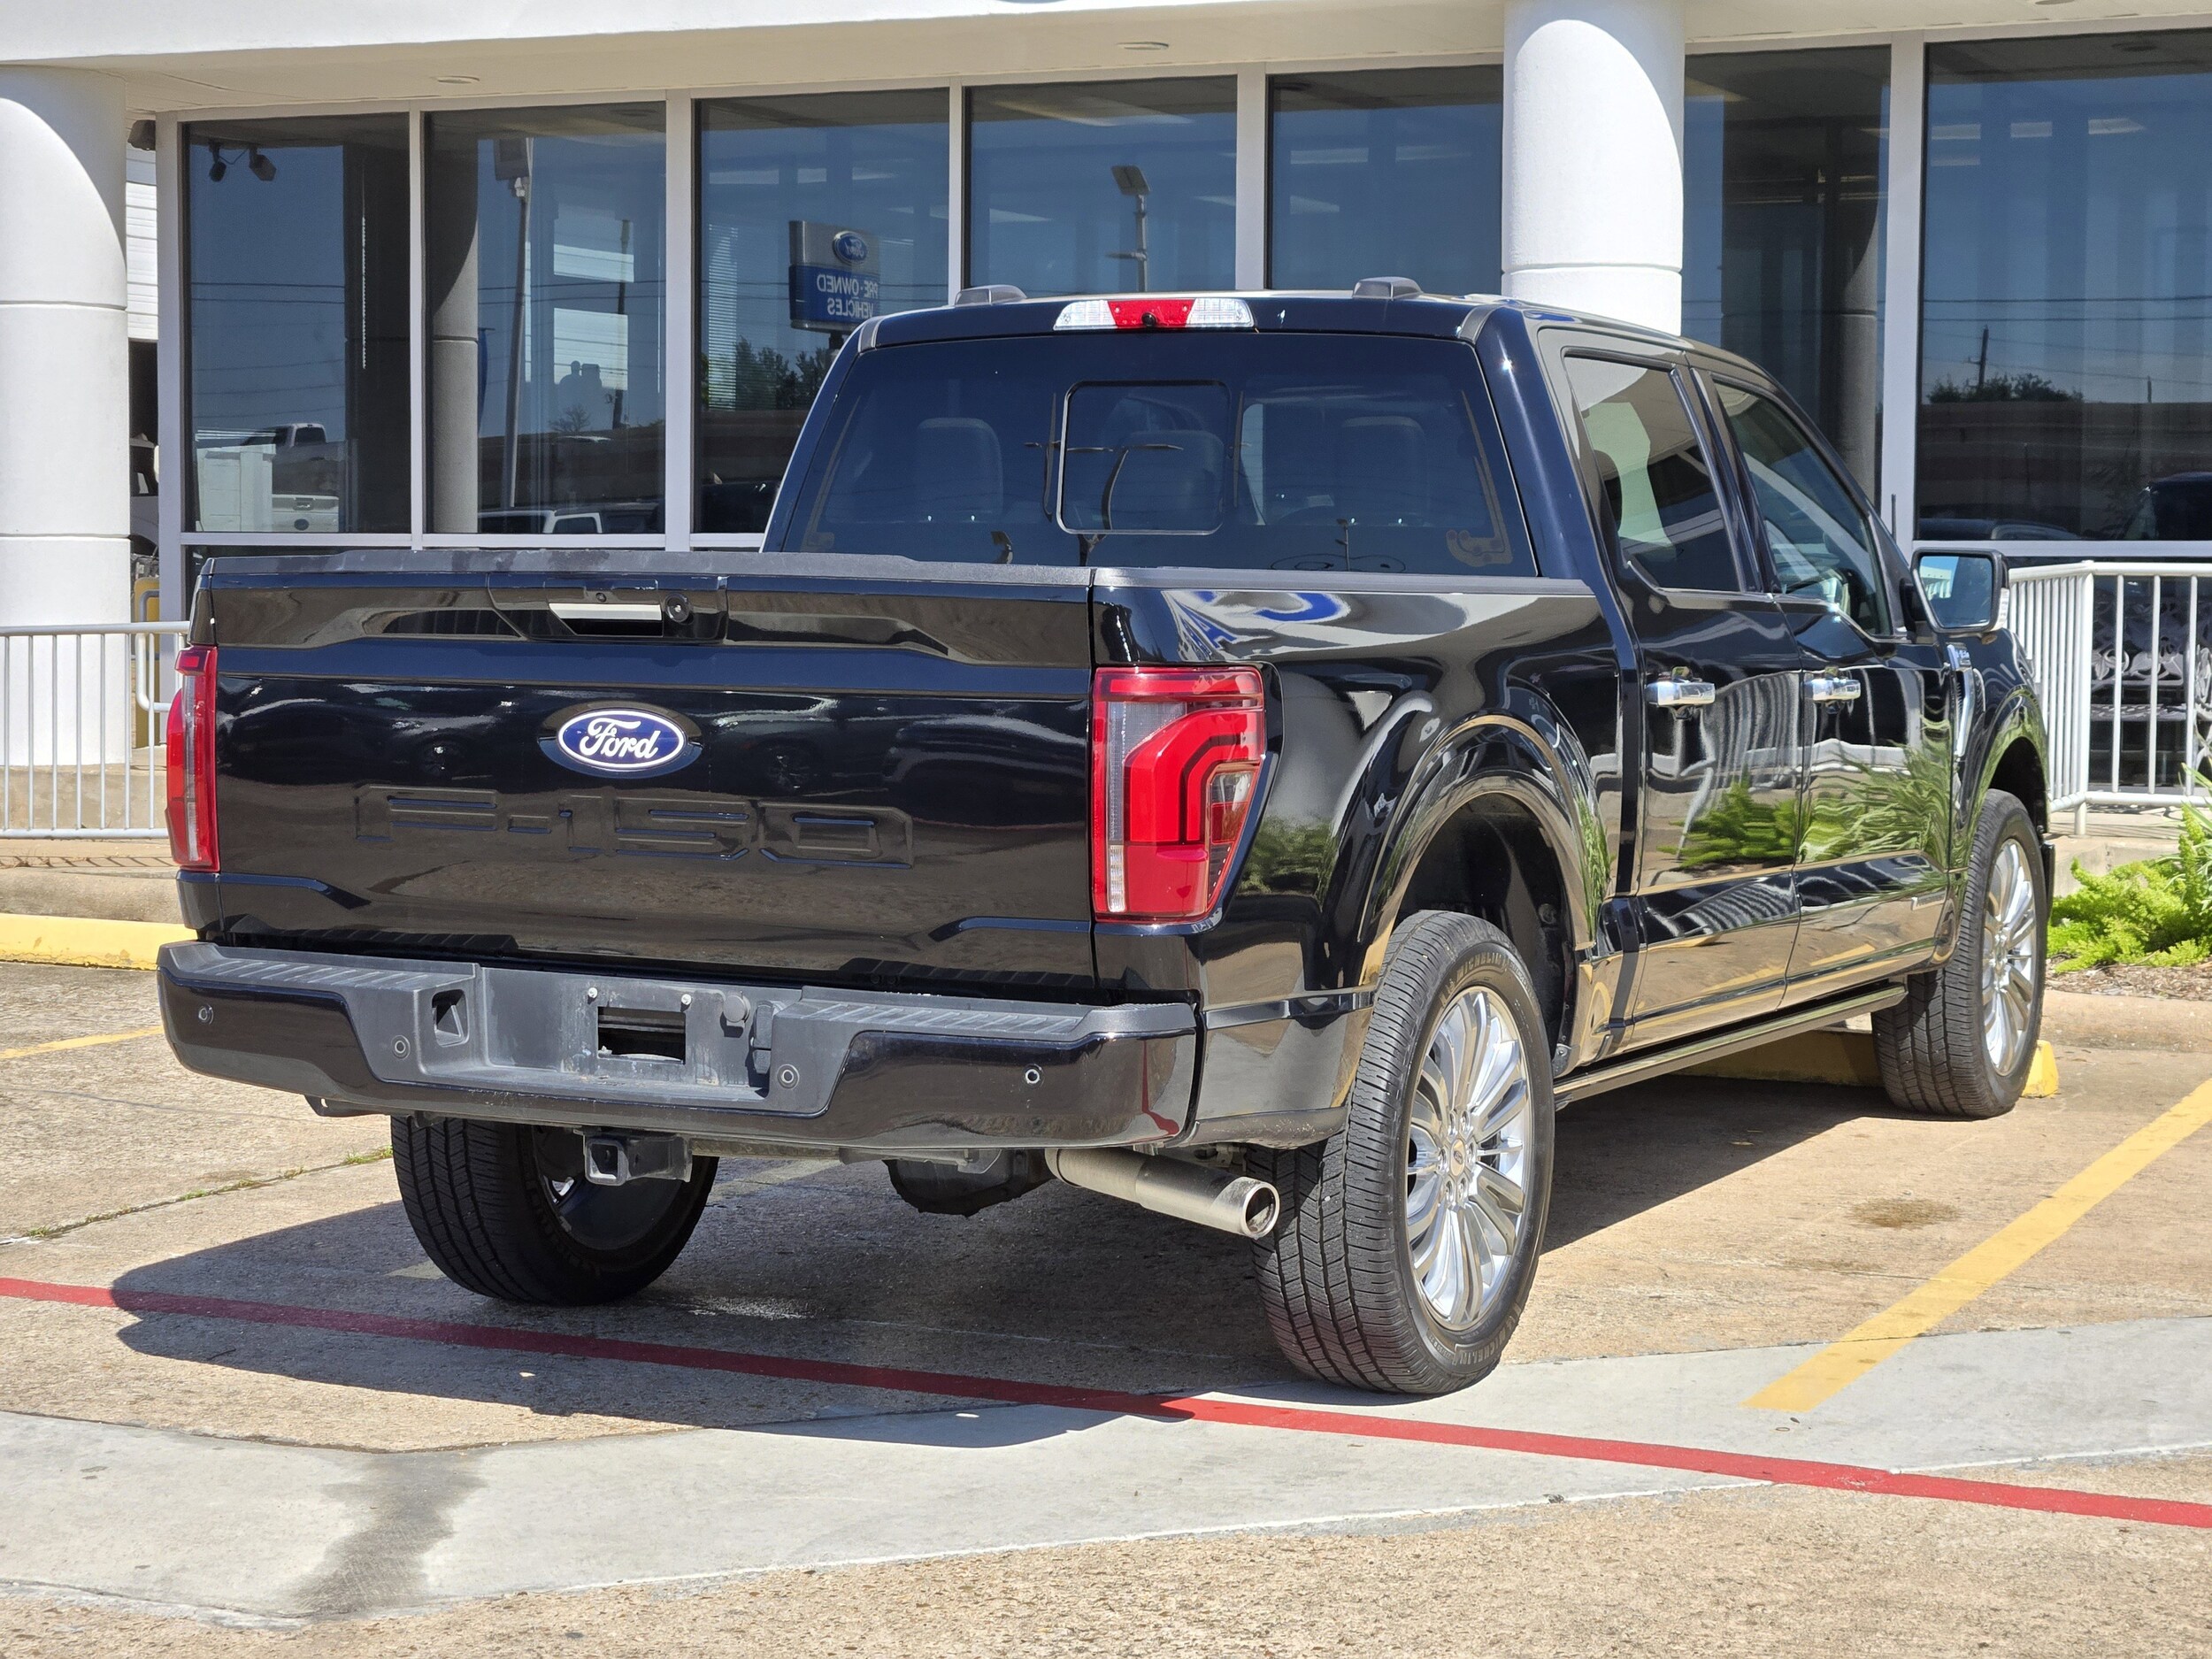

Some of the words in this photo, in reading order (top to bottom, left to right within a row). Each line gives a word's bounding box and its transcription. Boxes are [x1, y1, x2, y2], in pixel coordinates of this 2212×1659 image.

[579, 717, 662, 759] Ford
[355, 784, 914, 870] F-150
[1456, 951, 1502, 979] MICHELIN
[1459, 1326, 1507, 1366] MICHELIN
